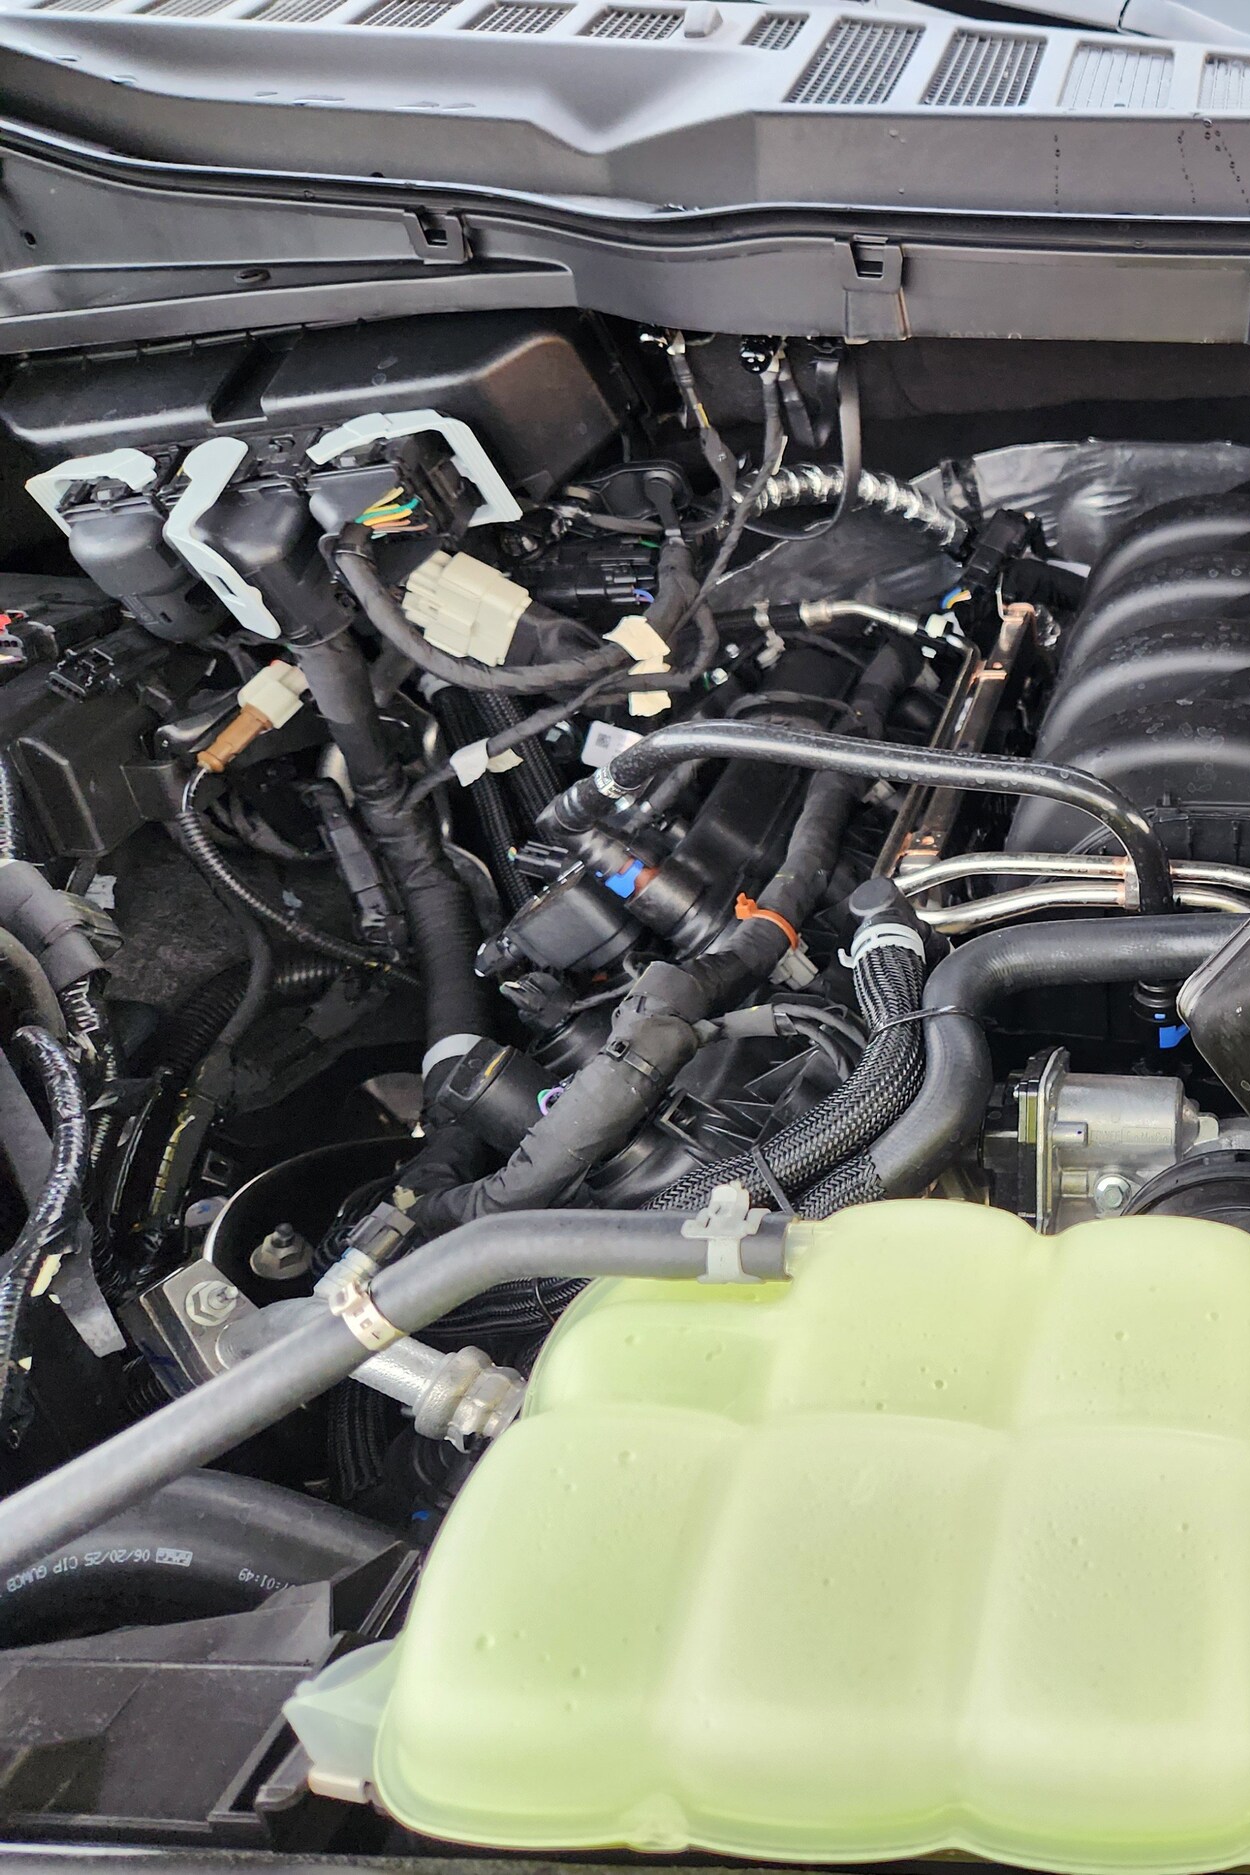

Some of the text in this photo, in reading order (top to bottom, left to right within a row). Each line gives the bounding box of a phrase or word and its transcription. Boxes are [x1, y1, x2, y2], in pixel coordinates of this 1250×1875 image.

[53, 1556, 79, 1574] CIP
[84, 1549, 151, 1567] 06/20/25
[238, 1567, 296, 1590] :01:49
